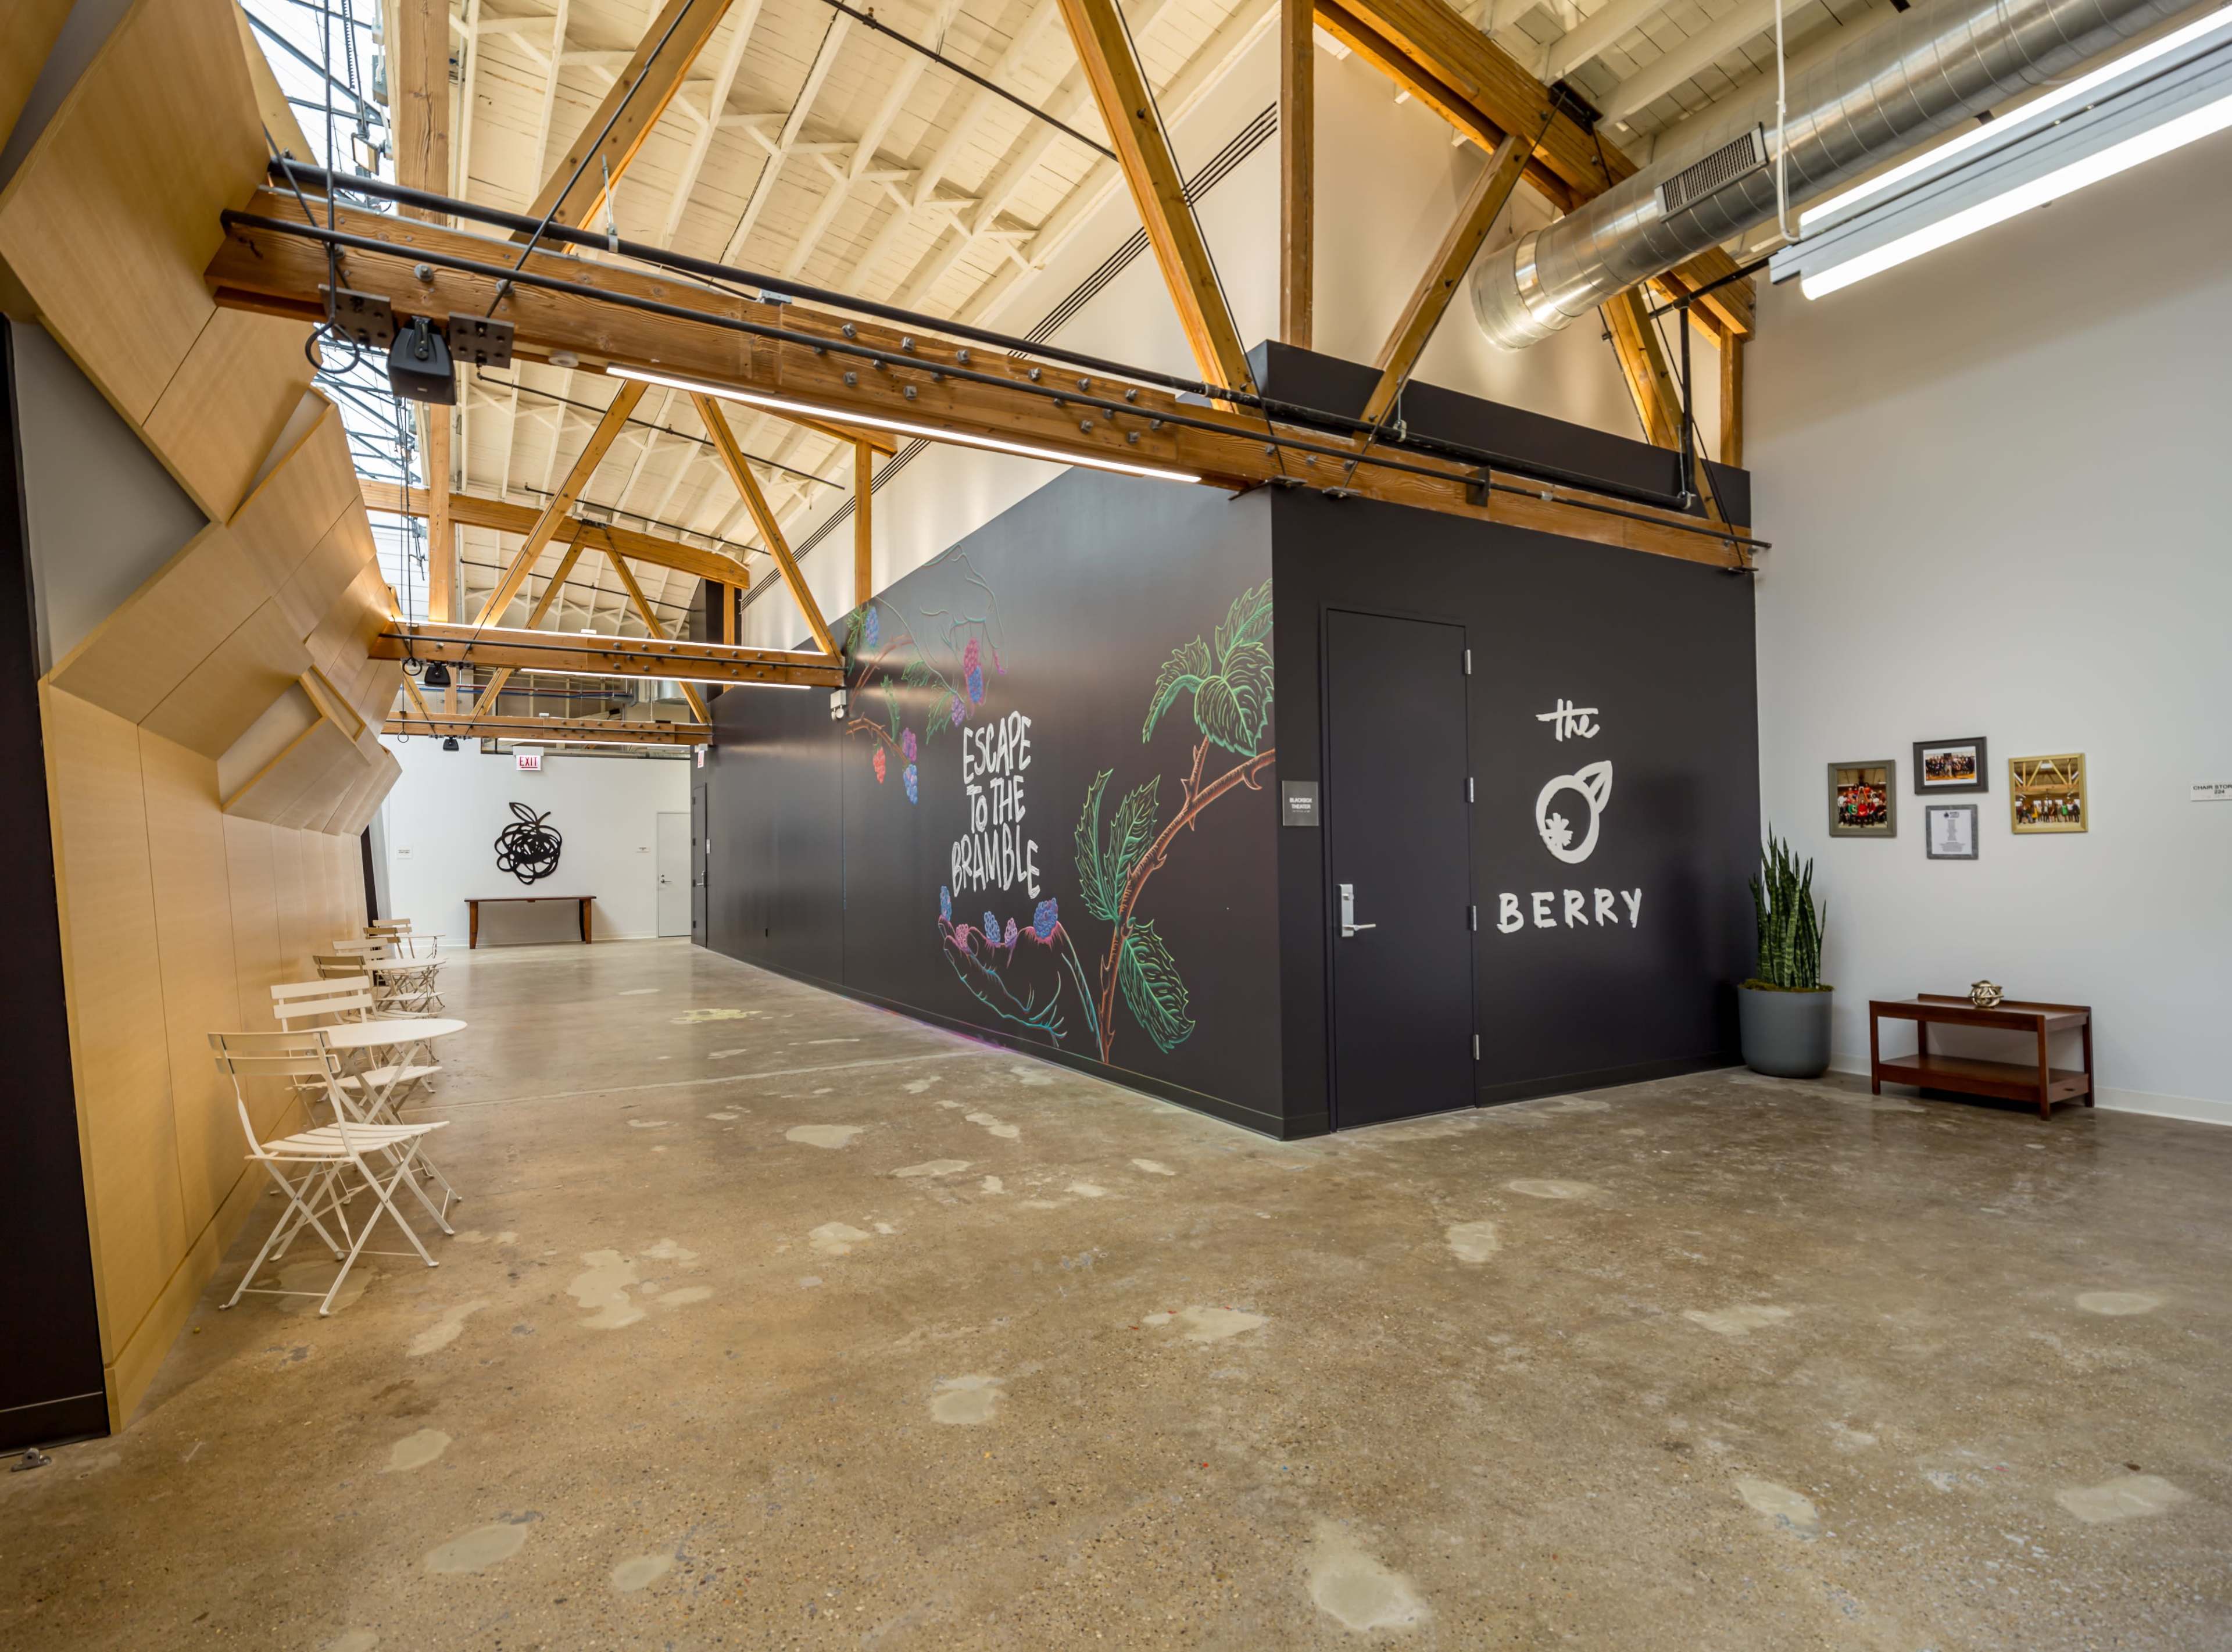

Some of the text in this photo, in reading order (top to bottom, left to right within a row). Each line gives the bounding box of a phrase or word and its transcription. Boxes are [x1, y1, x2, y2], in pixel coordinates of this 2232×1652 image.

[1536, 699, 1600, 742] the
[519, 756, 538, 766] EXIT
[963, 710, 1032, 784] ESCAPE
[966, 775, 1026, 834] TO THE
[951, 823, 1041, 899] BRAMBLE
[1497, 888, 1642, 934] BERRY
